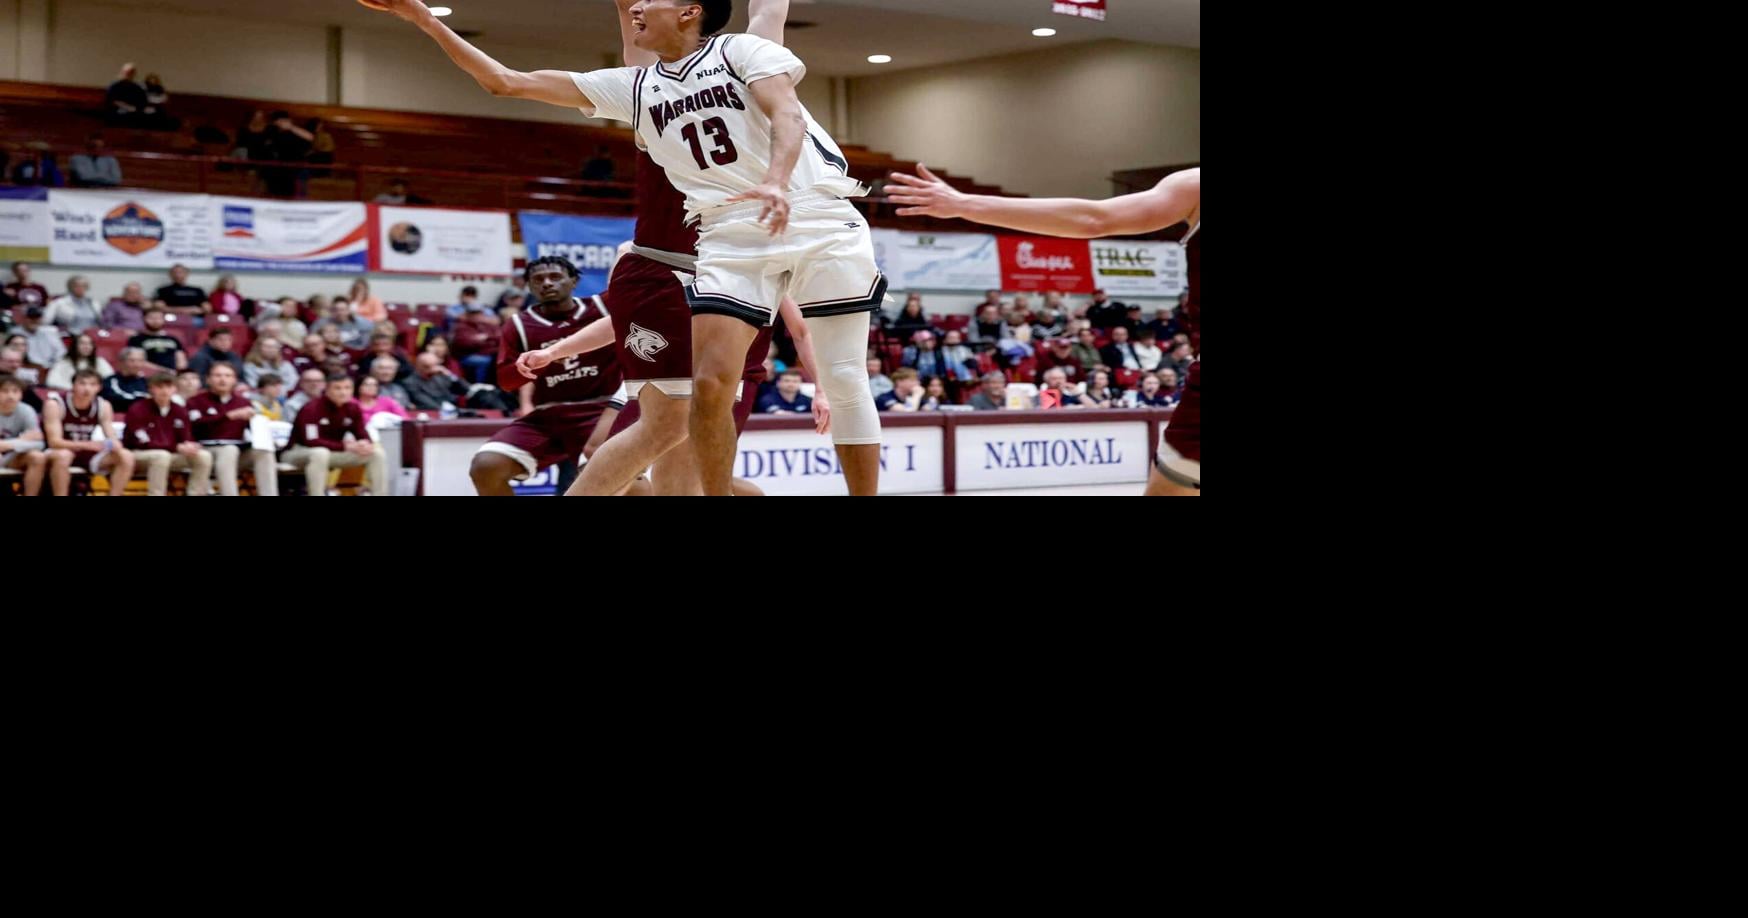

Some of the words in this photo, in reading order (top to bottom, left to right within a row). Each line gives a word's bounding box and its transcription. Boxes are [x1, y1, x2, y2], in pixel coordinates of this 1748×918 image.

[648, 82, 746, 138] WARRIORS
[681, 116, 738, 170] 13
[1095, 248, 1150, 267] TRAC
[905, 445, 916, 471] I
[985, 437, 1123, 470] NATIONAL
